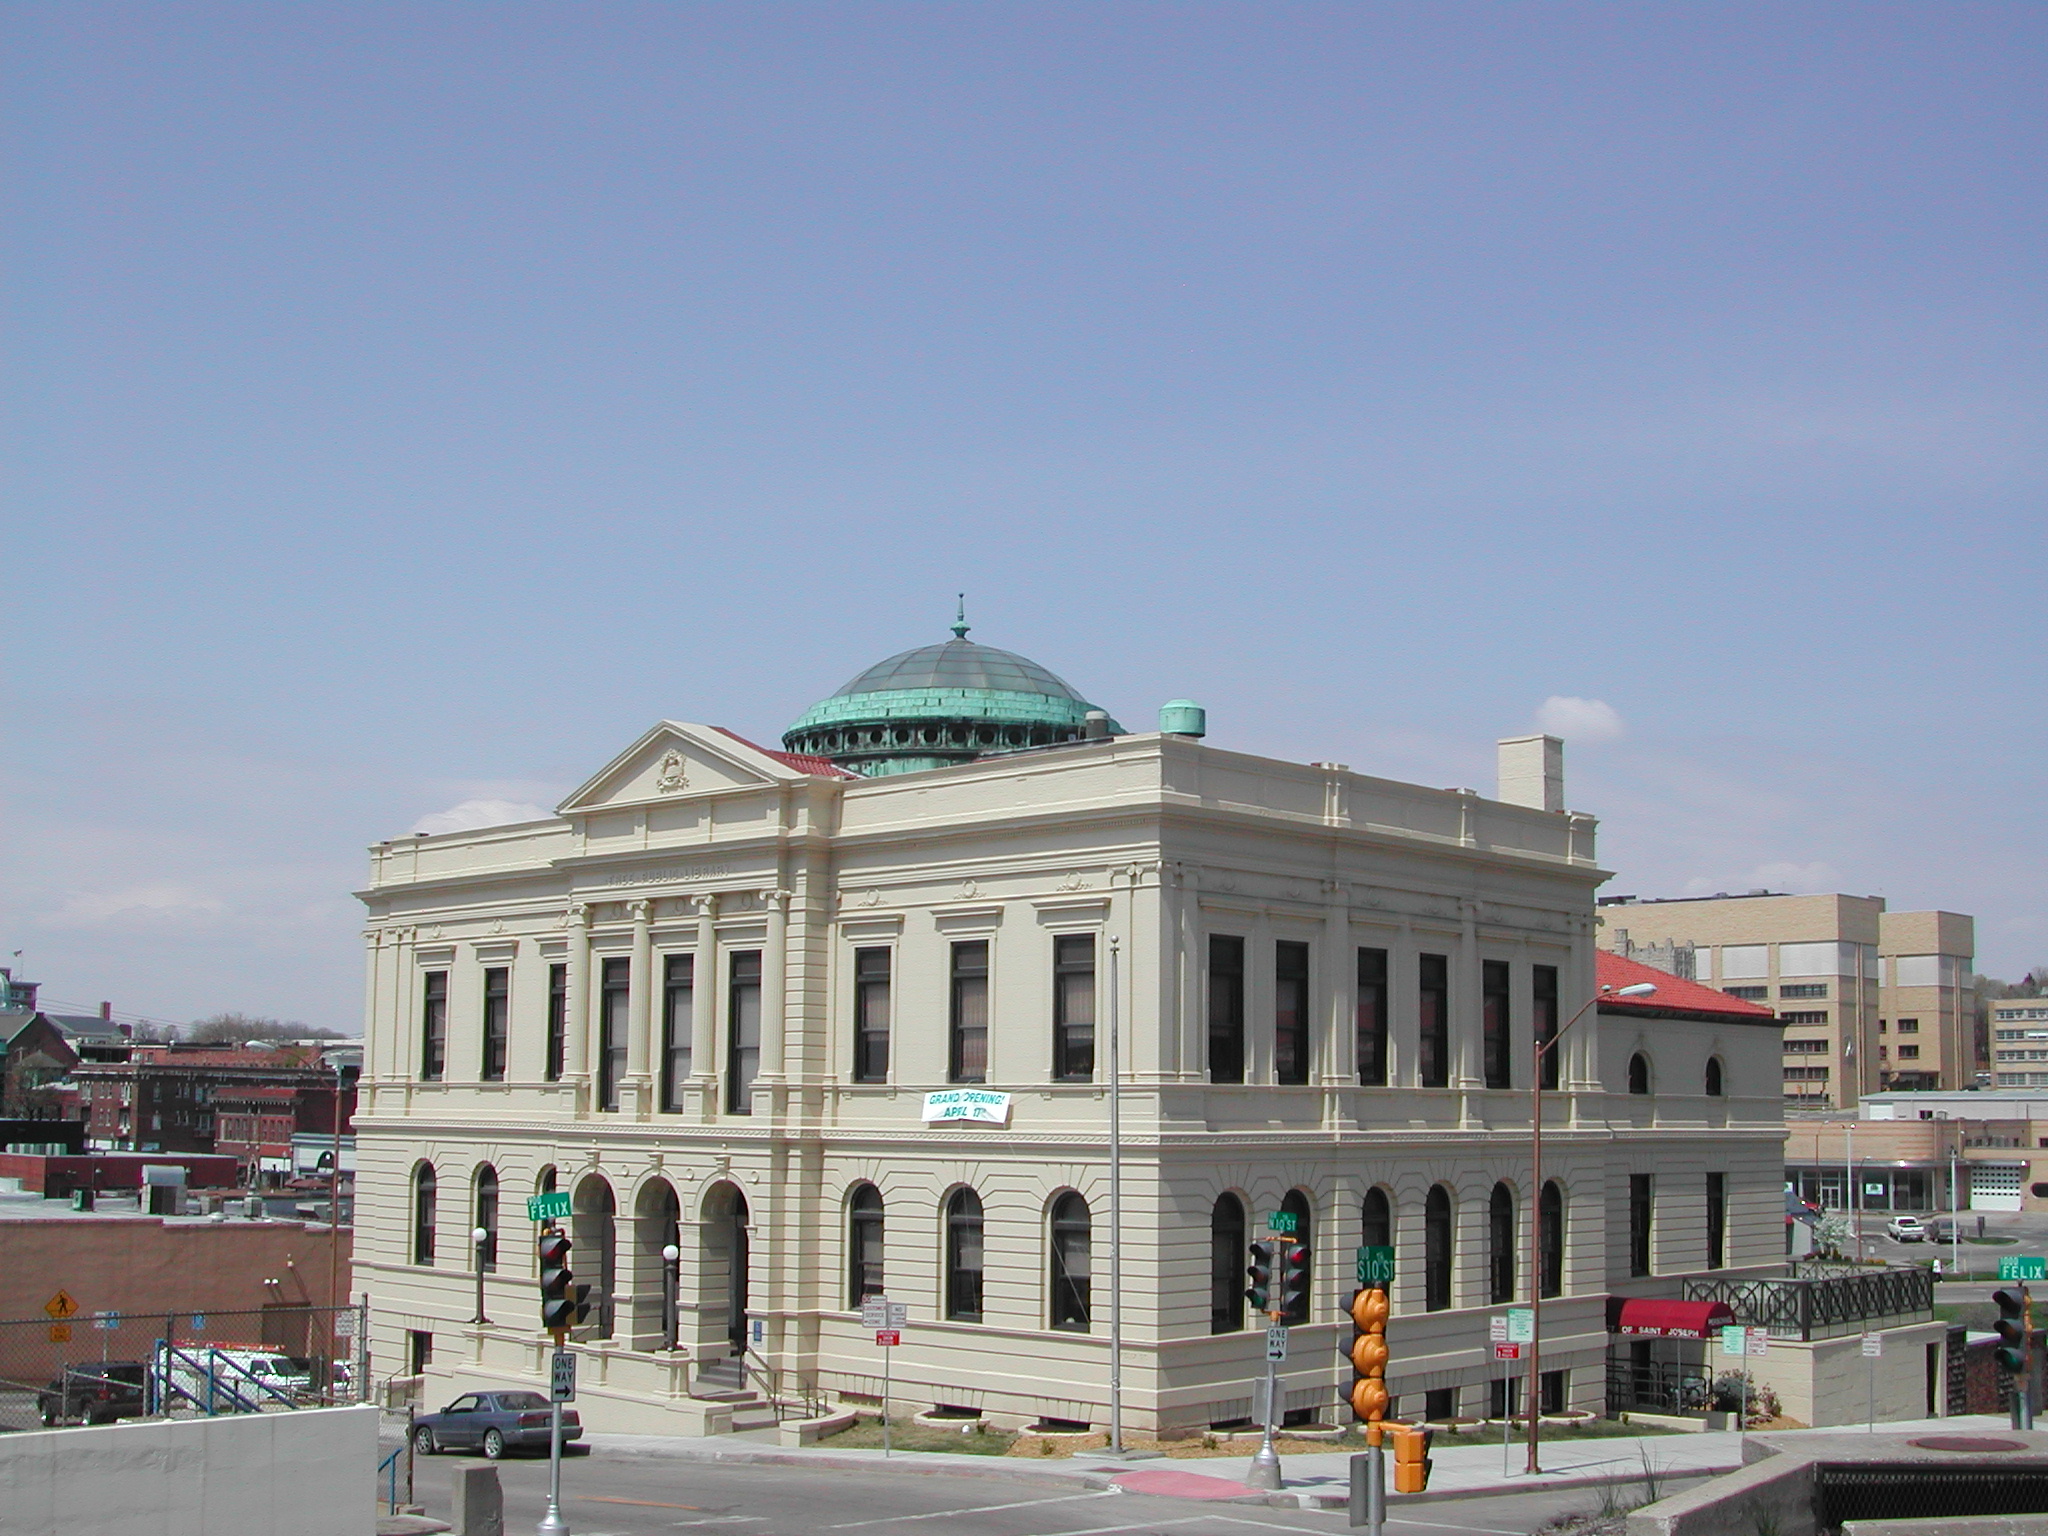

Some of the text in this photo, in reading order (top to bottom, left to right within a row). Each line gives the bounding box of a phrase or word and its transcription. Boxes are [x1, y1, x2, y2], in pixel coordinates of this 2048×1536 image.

[929, 1092, 960, 1104] GRAND
[530, 1201, 569, 1220] FELIX
[1286, 1220, 1297, 1230] ST
[1358, 1260, 1366, 1280] S
[1383, 1259, 1395, 1280] ST
[2003, 1265, 2043, 1279] FELIX
[1270, 1329, 1285, 1339] ONE
[1621, 1325, 1633, 1334] OF
[1638, 1326, 1662, 1335] SAINT
[1667, 1327, 1700, 1337] JOSEPH
[1269, 1339, 1286, 1348] WAY
[555, 1357, 573, 1370] ONE
[554, 1370, 574, 1383] WAY
